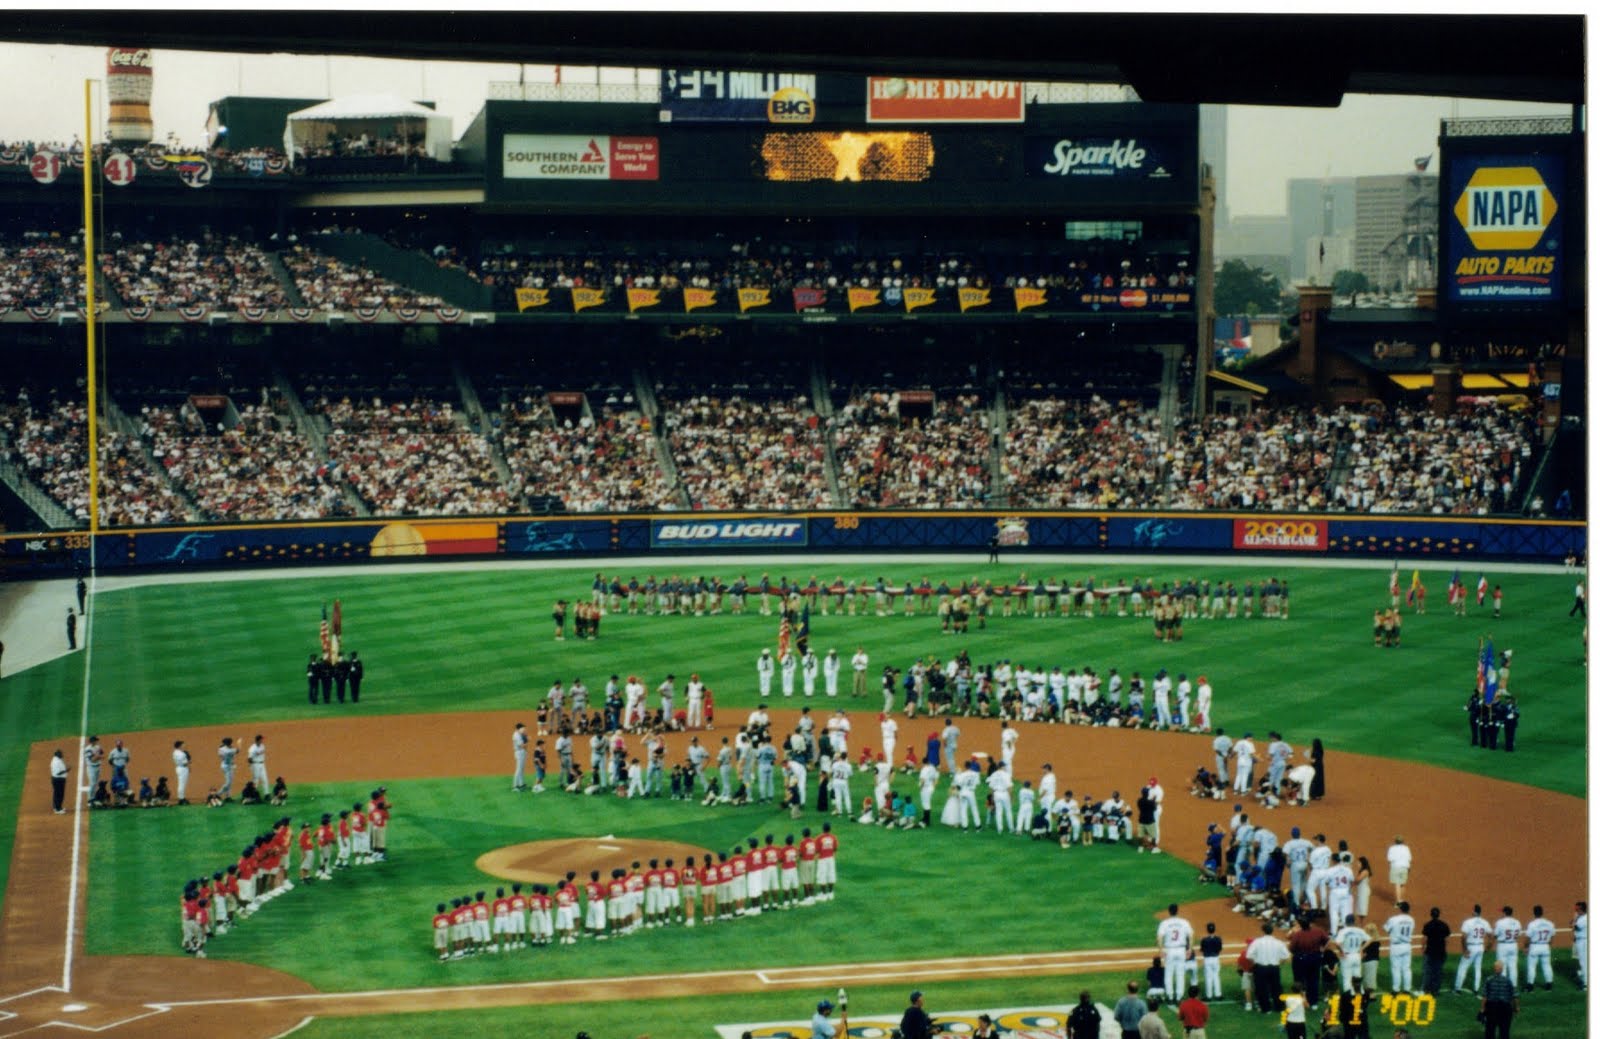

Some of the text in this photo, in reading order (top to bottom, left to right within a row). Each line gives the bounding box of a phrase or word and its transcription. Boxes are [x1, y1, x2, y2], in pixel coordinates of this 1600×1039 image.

[873, 80, 1019, 100] HME DEPOT
[772, 101, 810, 115] BIG
[617, 141, 653, 152] Energy to
[507, 152, 577, 162] SOUTHERN
[1044, 139, 1146, 176] Sparkle
[31, 155, 59, 176] 21
[104, 158, 134, 181] 41
[181, 161, 210, 184] 42
[540, 164, 605, 174] COMPANY
[1474, 190, 1538, 226] NAPA
[1455, 256, 1555, 275] AUTO PARTS
[1459, 286, 1551, 295] www.NAPAonline.com
[658, 523, 801, 539] BUD LIGHT
[834, 517, 859, 529] 380
[1245, 521, 1317, 537] 2000
[26, 537, 90, 550] NBC 335
[1171, 930, 1179, 941] 3
